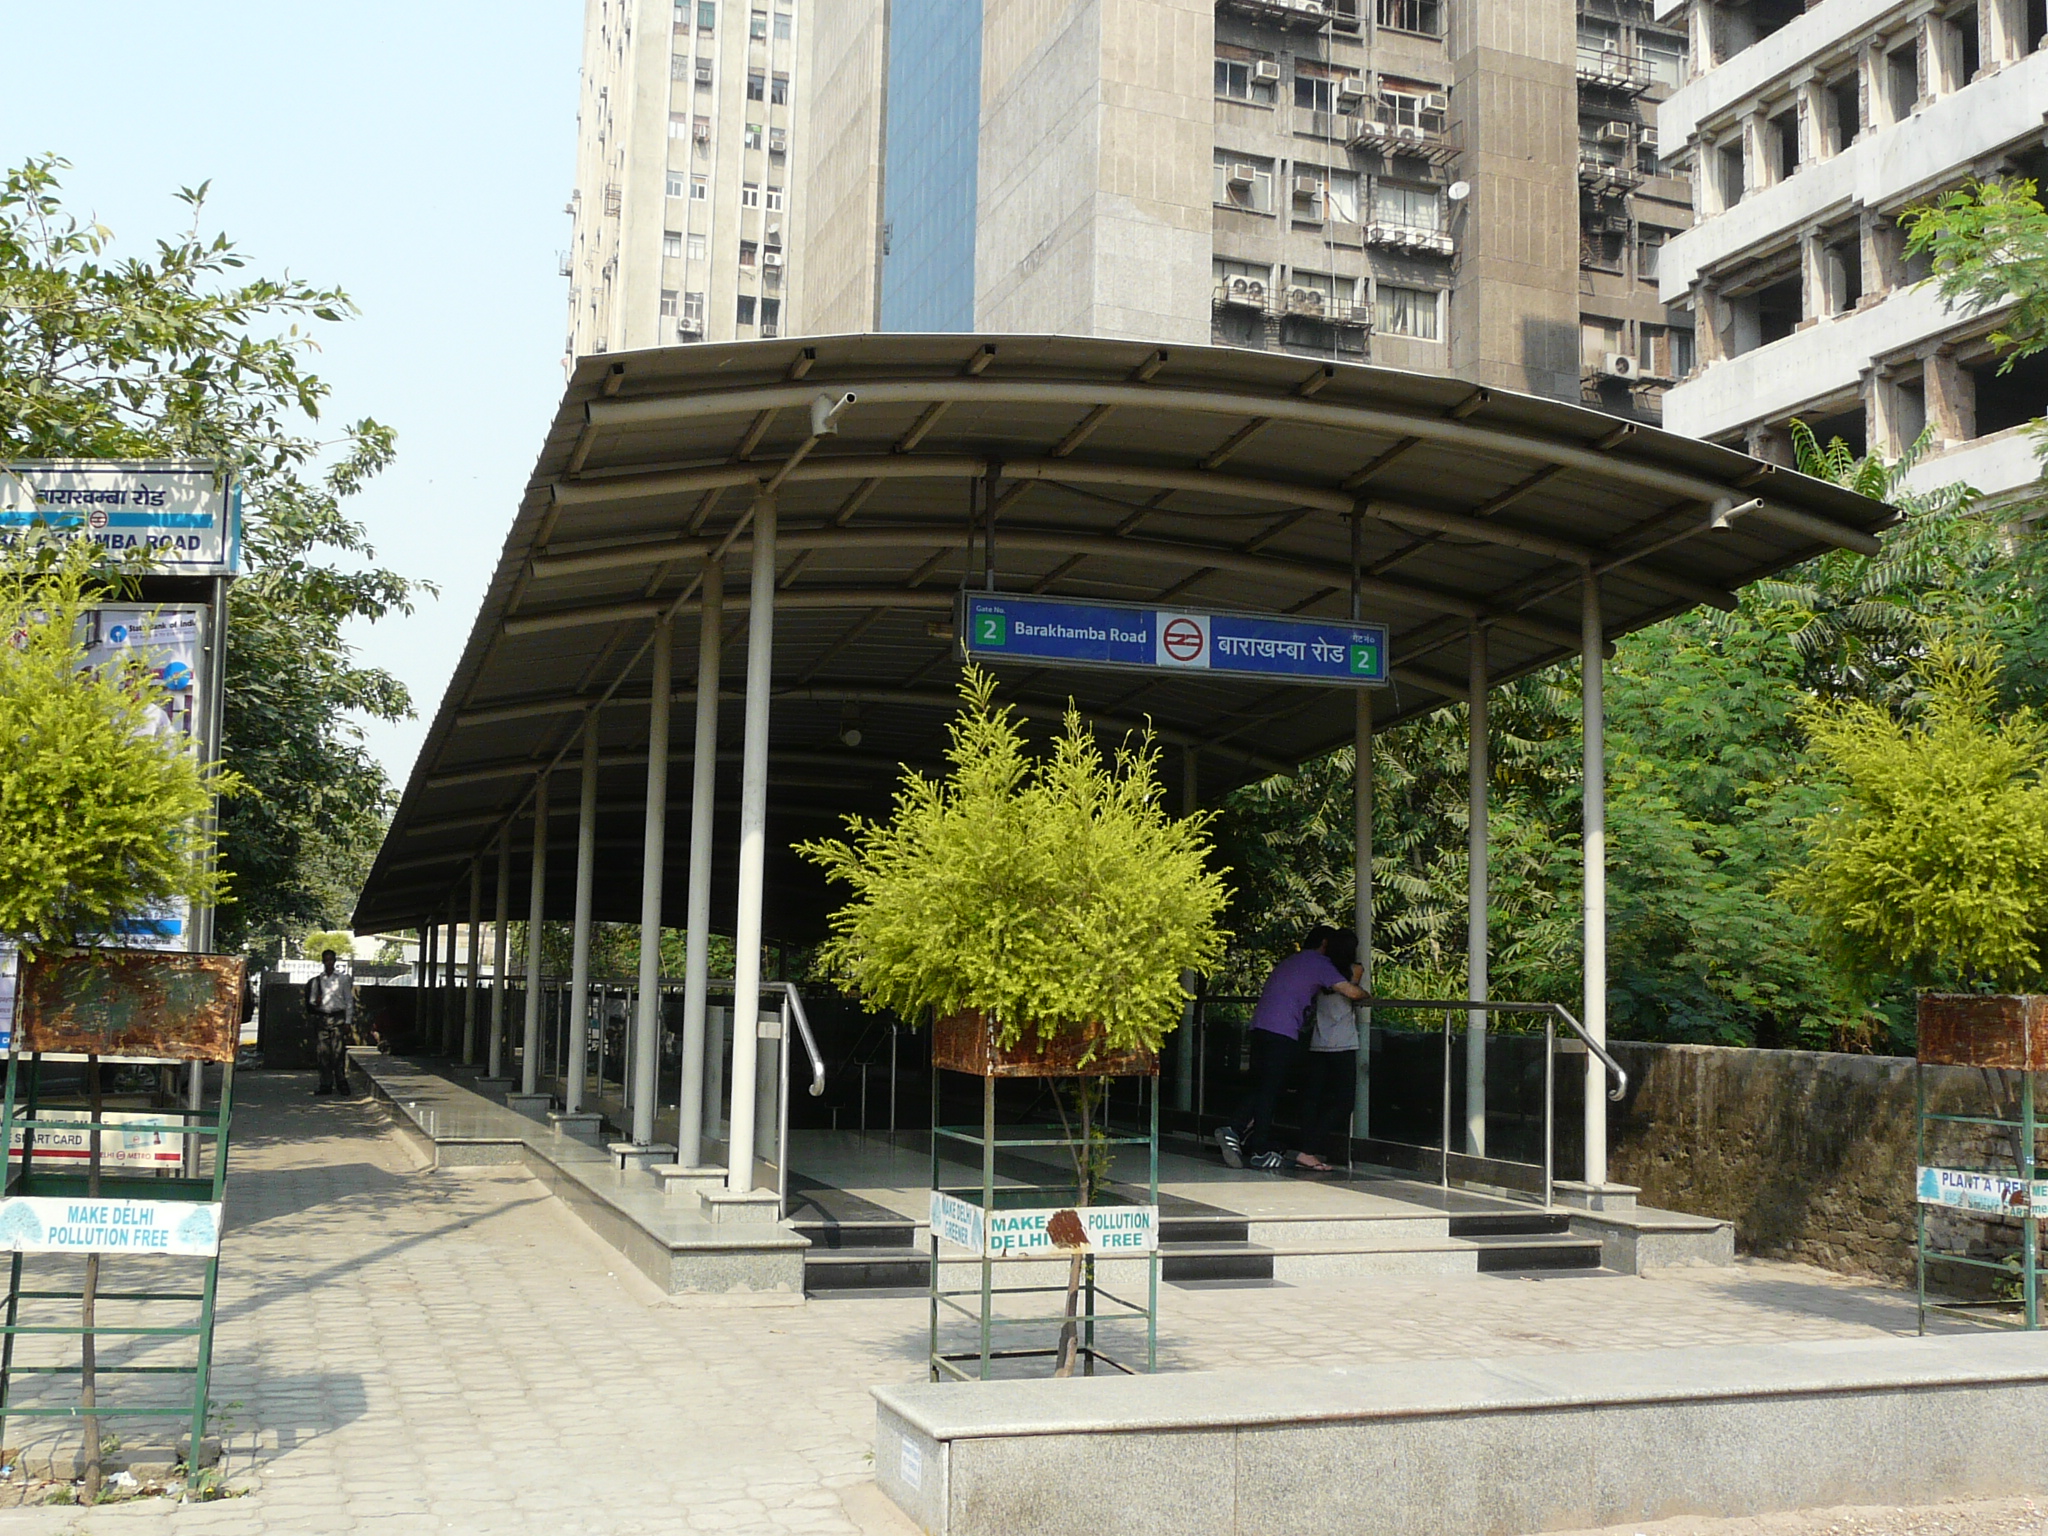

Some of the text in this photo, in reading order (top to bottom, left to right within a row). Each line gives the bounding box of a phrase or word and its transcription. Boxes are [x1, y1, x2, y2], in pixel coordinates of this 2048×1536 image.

[131, 483, 166, 507] रोड
[146, 534, 201, 551] ROAD
[975, 604, 1006, 615] Gate No.
[983, 620, 997, 639] 2
[1015, 621, 1147, 643] Barakhamba Road
[1217, 635, 1346, 663] बाराखम्बा रोड
[1357, 650, 1370, 669] 2
[53, 1134, 83, 1145] CARD
[1942, 1172, 1981, 1189] PLANT
[1984, 1178, 1992, 1192] A
[67, 1205, 155, 1226] MAKE DELHI
[992, 1215, 1045, 1232] MAKE
[1089, 1212, 1150, 1230] POLLUTION
[48, 1226, 169, 1248] POLLUTION FREE
[991, 1233, 1049, 1249] DELHI
[1102, 1232, 1143, 1248] FREE
